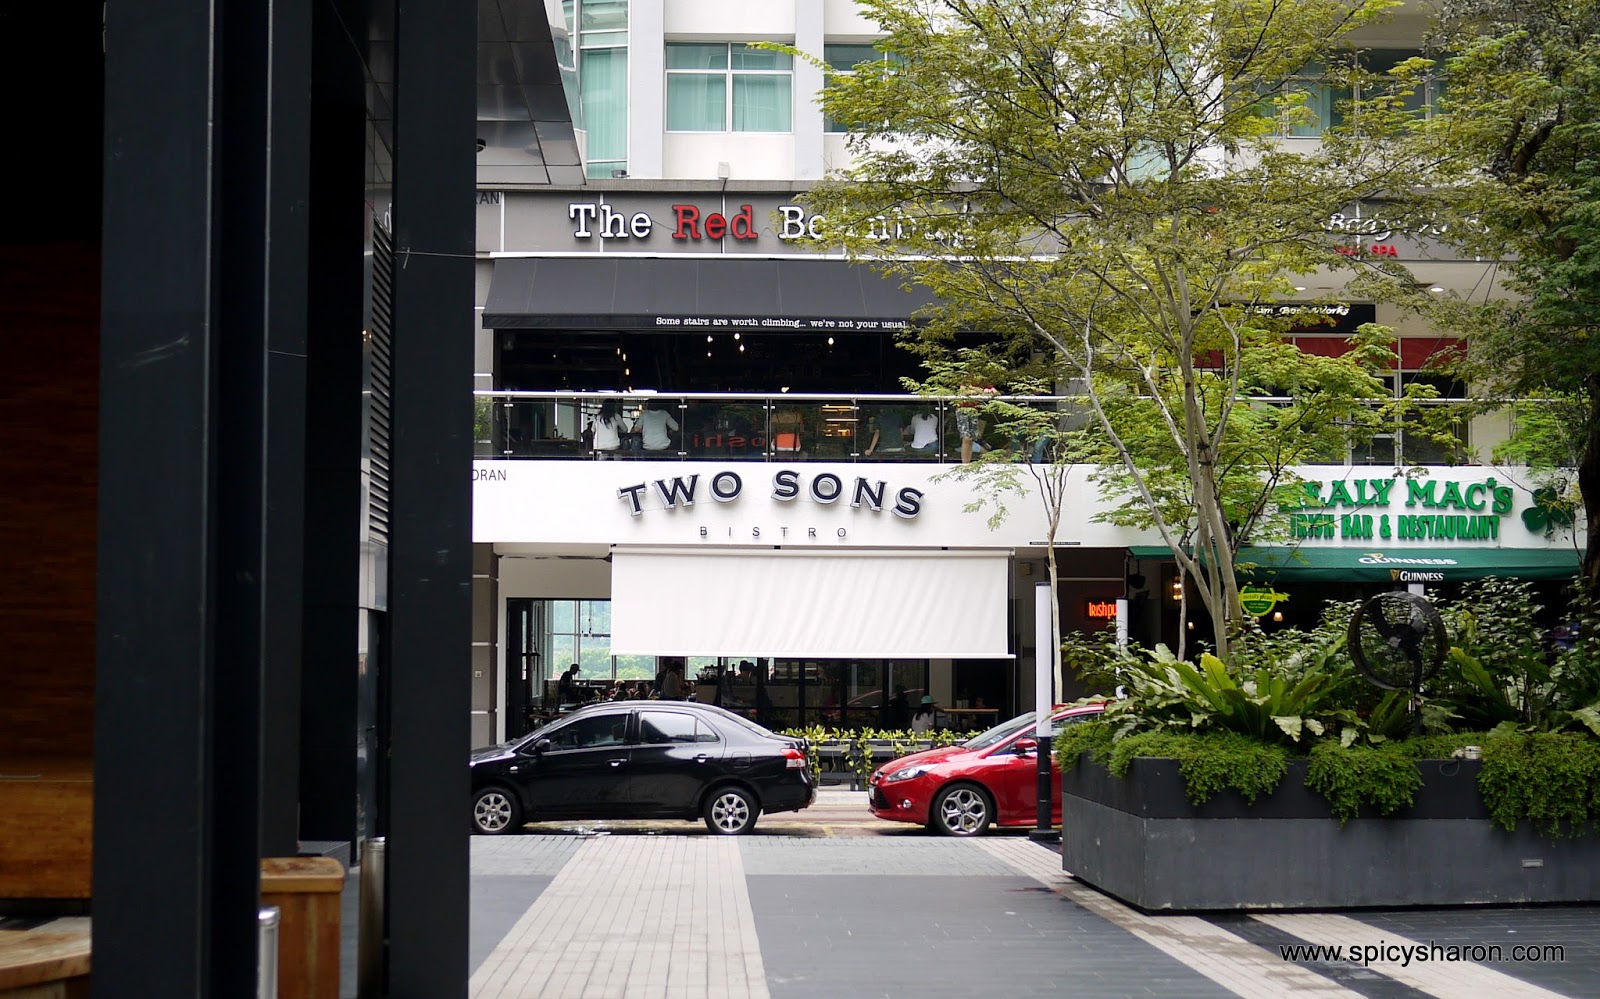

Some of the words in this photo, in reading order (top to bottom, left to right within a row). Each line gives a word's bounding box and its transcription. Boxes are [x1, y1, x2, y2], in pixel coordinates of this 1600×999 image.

[569, 203, 652, 239] The
[672, 204, 758, 239] Red
[1372, 244, 1398, 257] SPA
[656, 316, 680, 325] Some
[683, 317, 710, 326] stairs
[712, 318, 728, 326] are
[731, 318, 759, 326] worth
[761, 318, 807, 329] climbing...
[810, 319, 836, 328] we're
[838, 320, 854, 328] not
[856, 320, 879, 329] your
[616, 470, 743, 517] TWO
[771, 470, 925, 519] SONS
[1279, 479, 1396, 511] EALY
[700, 526, 846, 538] BISTRO
[1341, 514, 1373, 537] BAR
[1379, 514, 1391, 538] &
[1398, 515, 1499, 539] RESTAURANT
[1358, 557, 1458, 565] GUINNESS
[1399, 570, 1445, 582] GUINNESS
